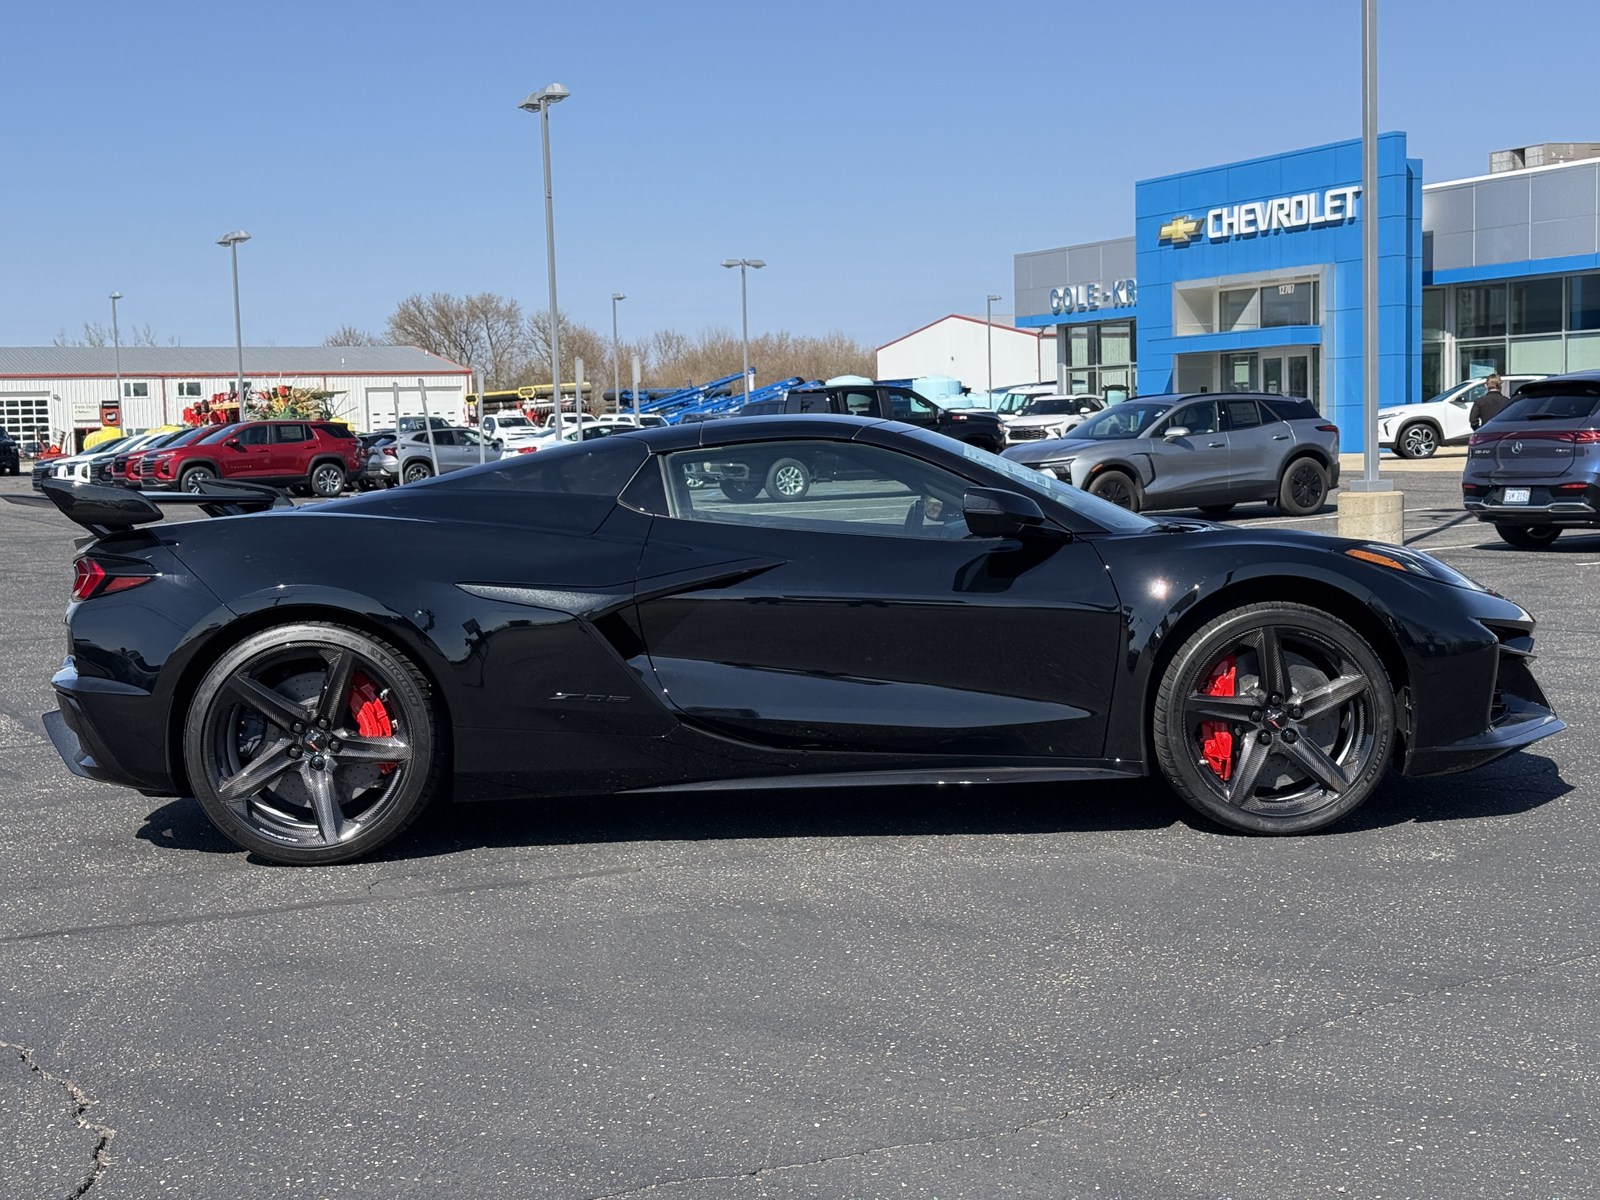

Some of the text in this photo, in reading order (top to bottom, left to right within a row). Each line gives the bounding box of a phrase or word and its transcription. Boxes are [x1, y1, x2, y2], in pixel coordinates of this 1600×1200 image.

[1207, 186, 1361, 240] CHEVROLET
[1278, 284, 1295, 295] 12707
[382, 658, 419, 705] MICHELIN
[1366, 733, 1388, 781] MICHELIN
